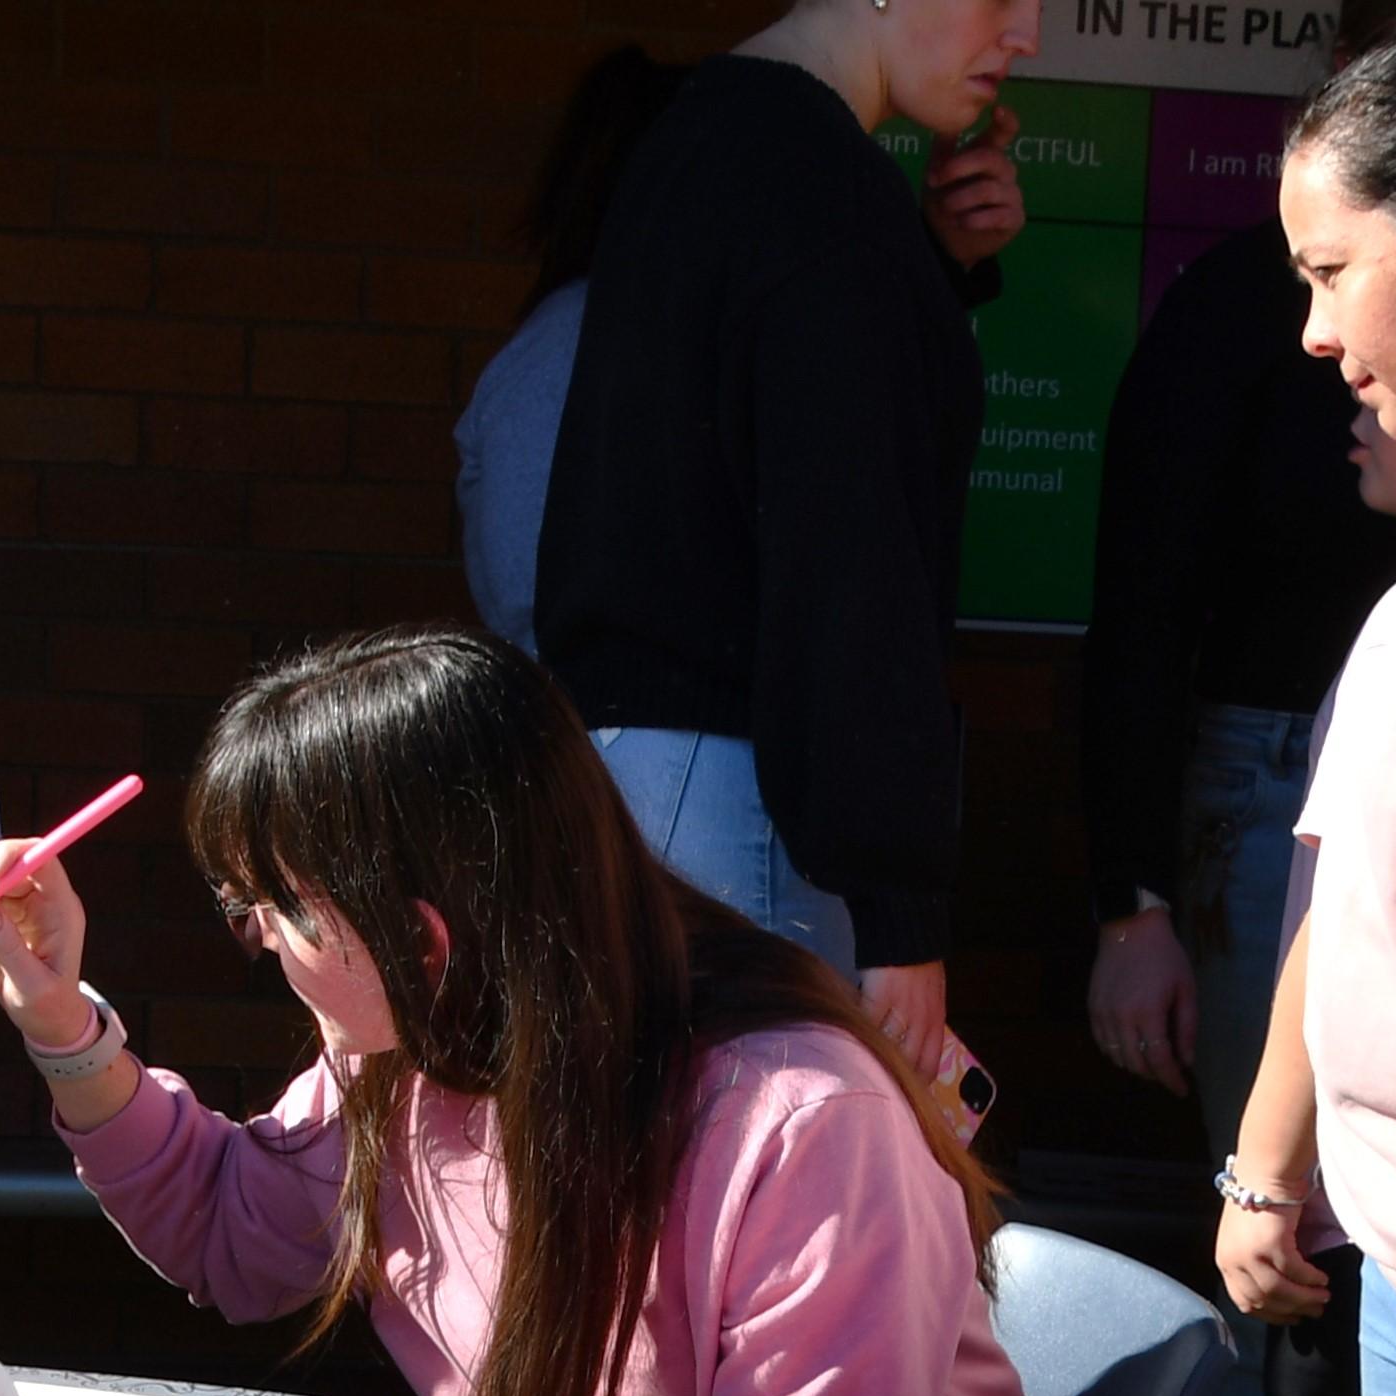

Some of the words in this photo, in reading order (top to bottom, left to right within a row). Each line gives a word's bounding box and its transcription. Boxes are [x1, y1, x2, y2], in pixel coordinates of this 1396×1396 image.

[1076, 0, 1123, 36] IN
[1140, 2, 1227, 44] THE
[1204, 154, 1246, 175] am
[981, 421, 1097, 453] uipment
